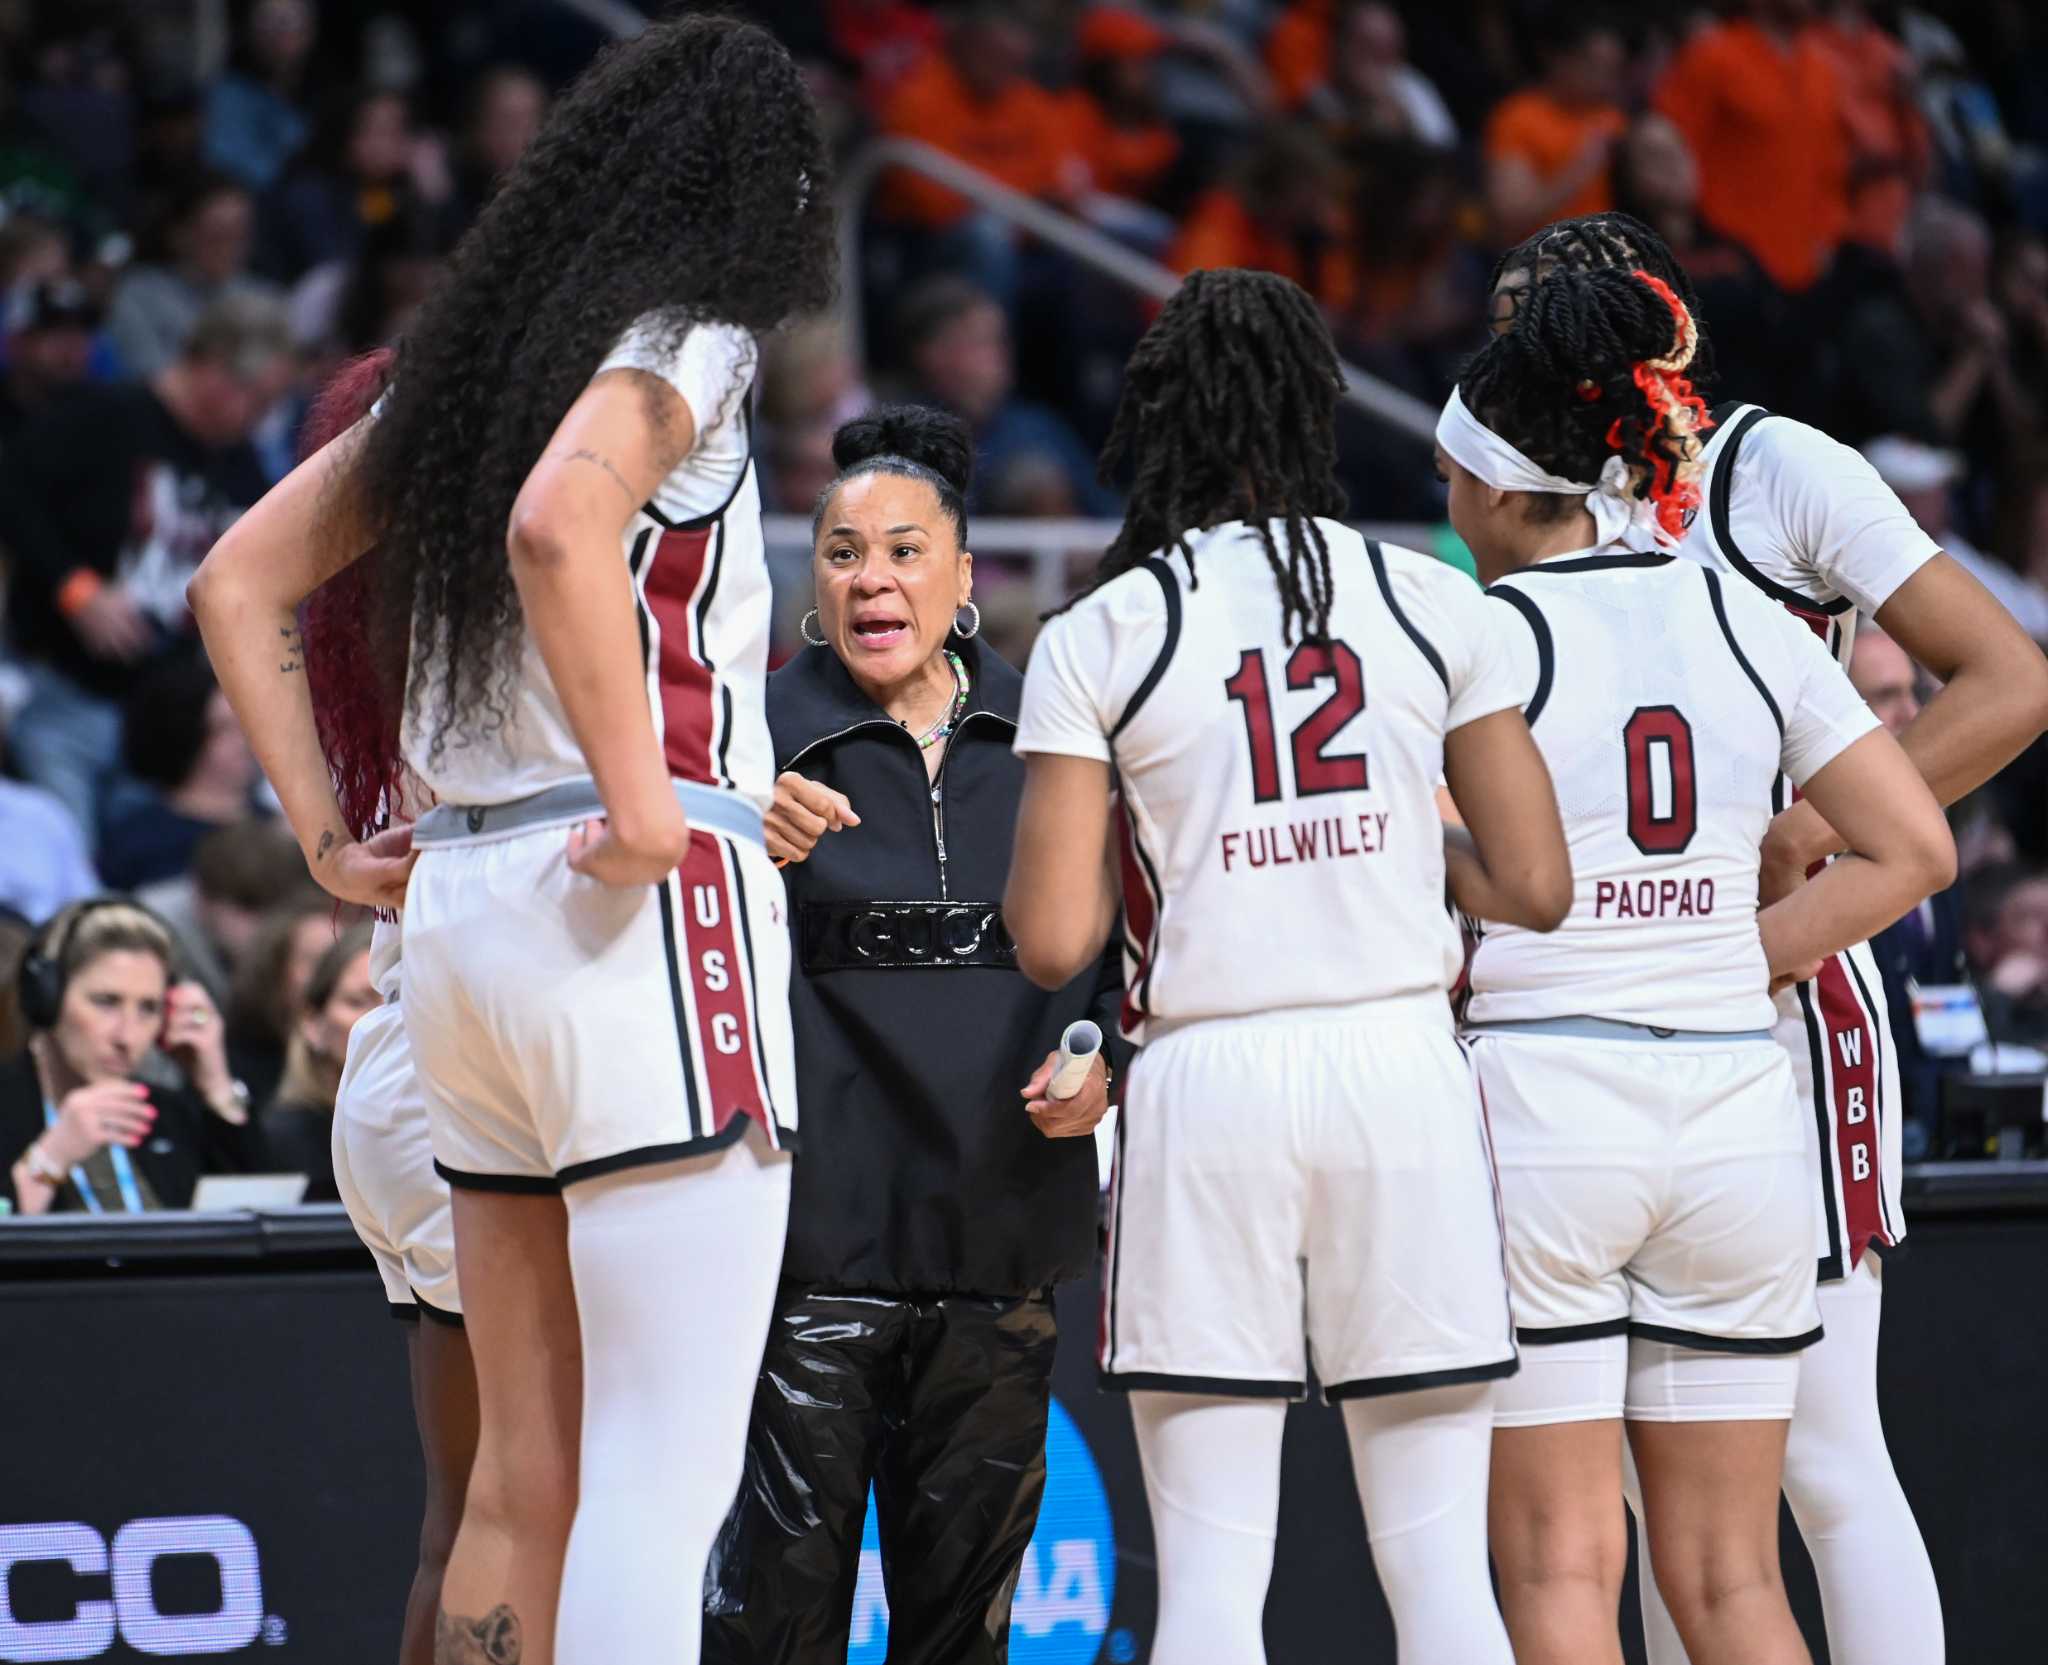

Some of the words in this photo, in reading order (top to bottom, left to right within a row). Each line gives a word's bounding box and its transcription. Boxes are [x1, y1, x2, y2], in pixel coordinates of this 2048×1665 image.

[1225, 638, 1370, 805] 12
[1623, 705, 1697, 856] 0
[1222, 813, 1388, 872] FULWILEY
[1595, 878, 1714, 918] PAOPAO
[693, 885, 741, 1054] USC
[1836, 1027, 1870, 1182] WBB
